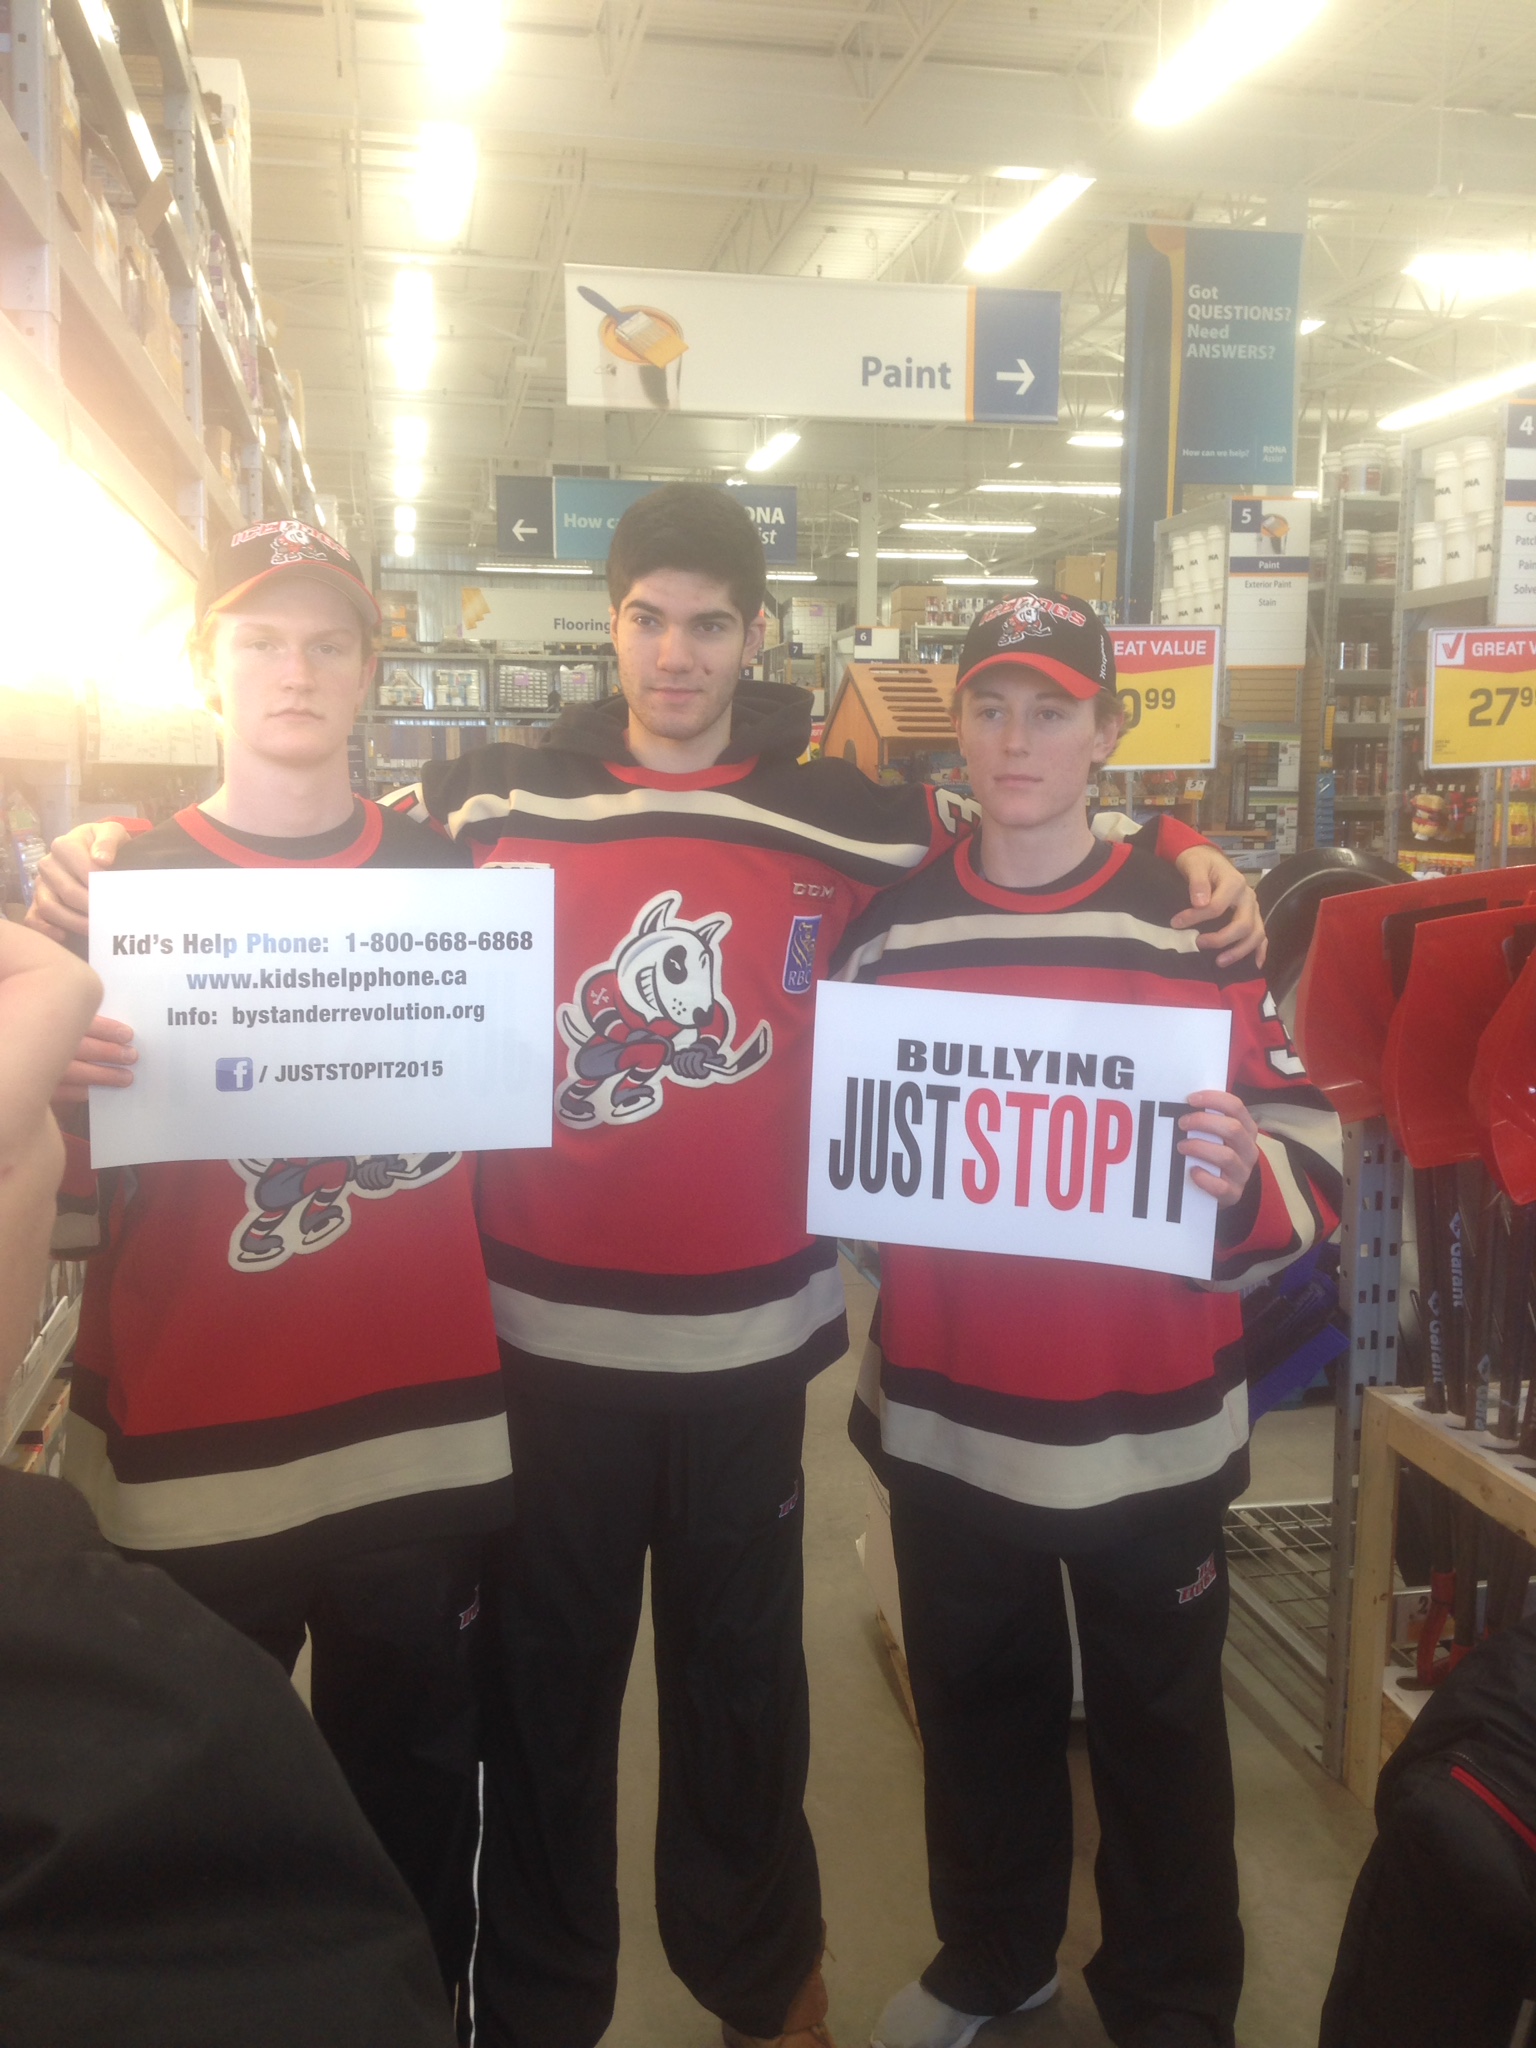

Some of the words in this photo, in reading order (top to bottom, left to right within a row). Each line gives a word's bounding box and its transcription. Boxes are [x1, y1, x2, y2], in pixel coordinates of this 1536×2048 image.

[1188, 284, 1219, 300] Got
[1188, 304, 1292, 322] QUESTIONS?
[1187, 324, 1230, 339] Need
[1186, 343, 1276, 360] ANSWERS?
[862, 356, 952, 390] Paint
[1519, 416, 1535, 435] 4
[1182, 448, 1201, 457] How
[1263, 445, 1287, 455] RONA
[564, 513, 602, 529] How
[1240, 508, 1252, 524] 5
[1258, 560, 1281, 570] Paint
[1244, 580, 1273, 589] Exterior
[1274, 580, 1292, 588] Paint
[1258, 599, 1277, 607] Stain
[553, 617, 611, 634] Flooring
[859, 632, 867, 641] 6
[792, 645, 799, 654] 7
[1114, 641, 1147, 655] EAT
[1151, 640, 1207, 655] VALUE
[1472, 641, 1526, 656] GREAT
[744, 669, 750, 677] 8
[793, 882, 835, 898] CCM
[113, 934, 173, 955] Kid's
[183, 933, 238, 958] Help
[247, 932, 329, 953] Phone:
[346, 931, 533, 952] 1-800-668-6868
[187, 967, 467, 991] www.kidshelpphone.ca
[167, 1007, 218, 1026] Info:
[232, 1002, 485, 1028] bystanderrevolution.org
[274, 1060, 443, 1082] JUSTSTOPIT2015
[897, 1038, 1136, 1091] BULLYING
[1450, 1241, 1464, 1308] Garant
[1428, 1320, 1444, 1383] Garant
